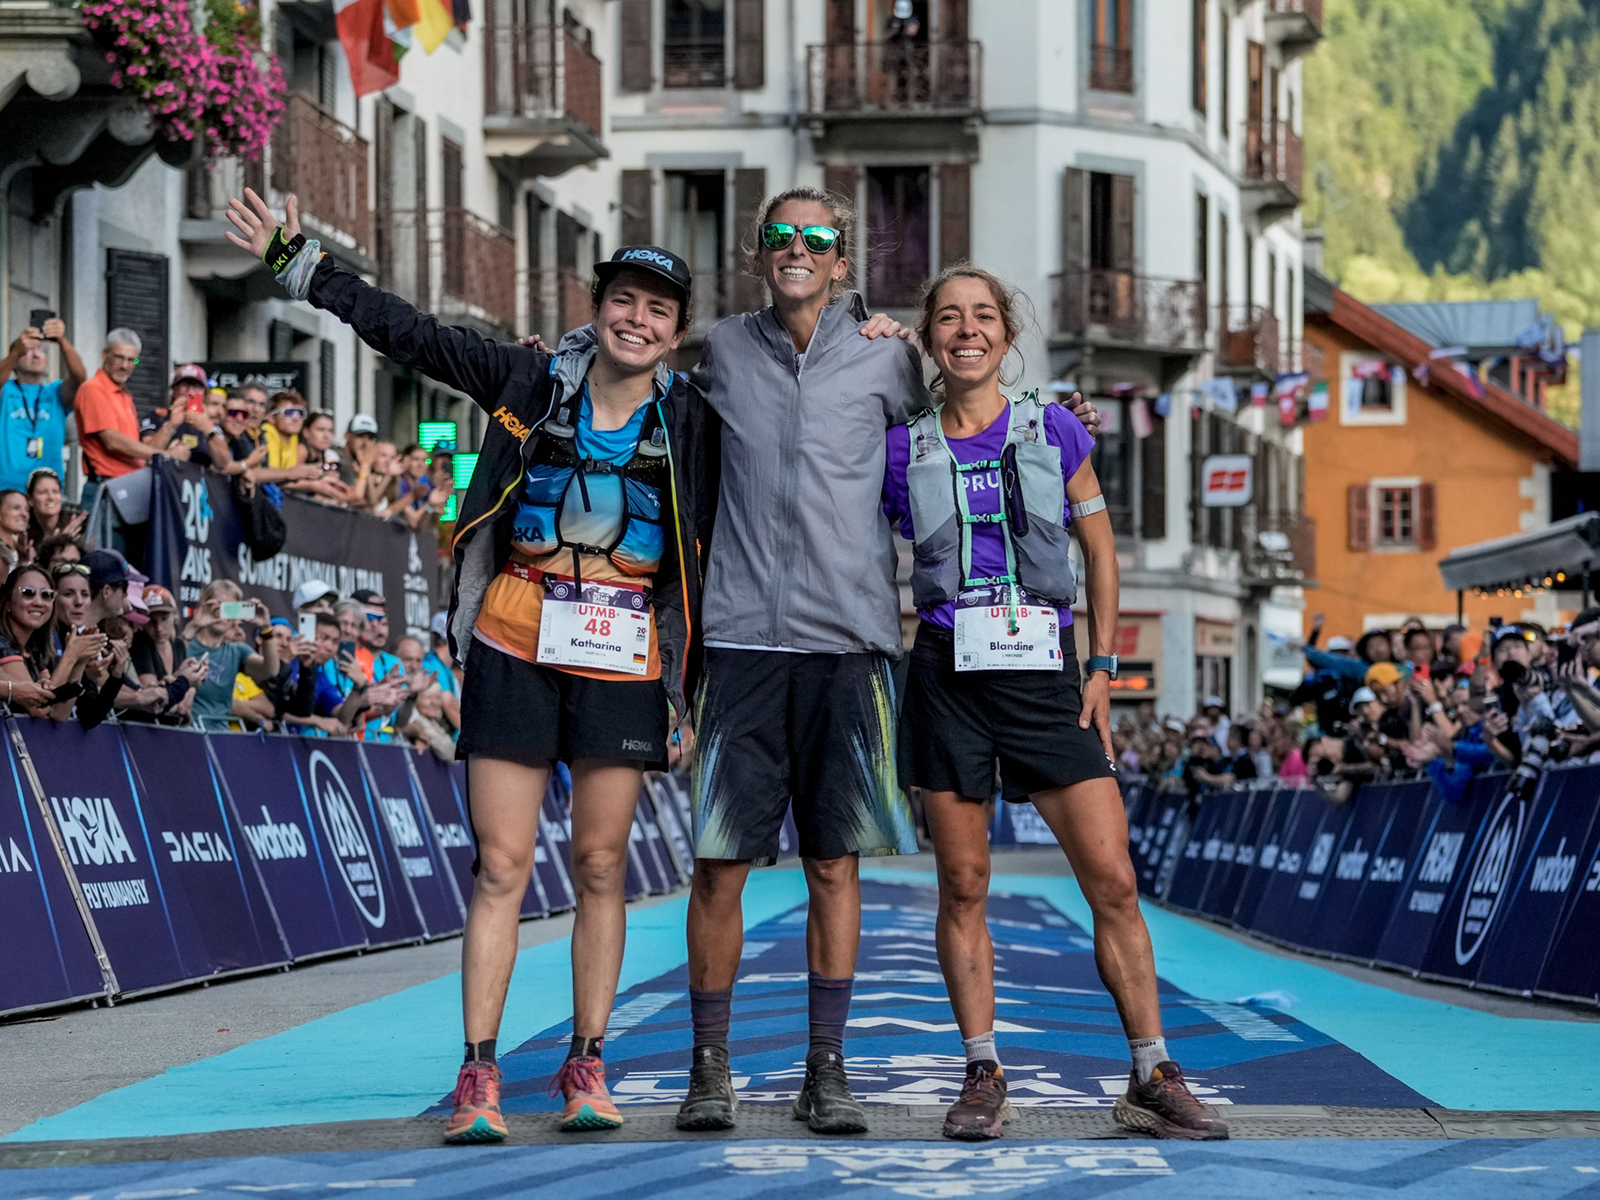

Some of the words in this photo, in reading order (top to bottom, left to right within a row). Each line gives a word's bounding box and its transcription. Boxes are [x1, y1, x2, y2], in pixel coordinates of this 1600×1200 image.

[270, 253, 289, 275] EKI
[621, 249, 674, 272] HOKA
[492, 406, 531, 443] HOKA
[181, 477, 209, 543] 20
[181, 544, 212, 585] ANS
[579, 604, 617, 619] UTMB
[584, 618, 612, 637] 48
[570, 638, 622, 652] Katharina
[989, 641, 1034, 652] Blandine
[622, 738, 653, 752] HOKA
[50, 796, 137, 866] HOKA
[243, 804, 308, 861] wahoo
[161, 831, 233, 863] DACIA
[81, 882, 103, 909] FLY
[98, 880, 138, 909] HUMAN
[130, 878, 150, 905] FLY
